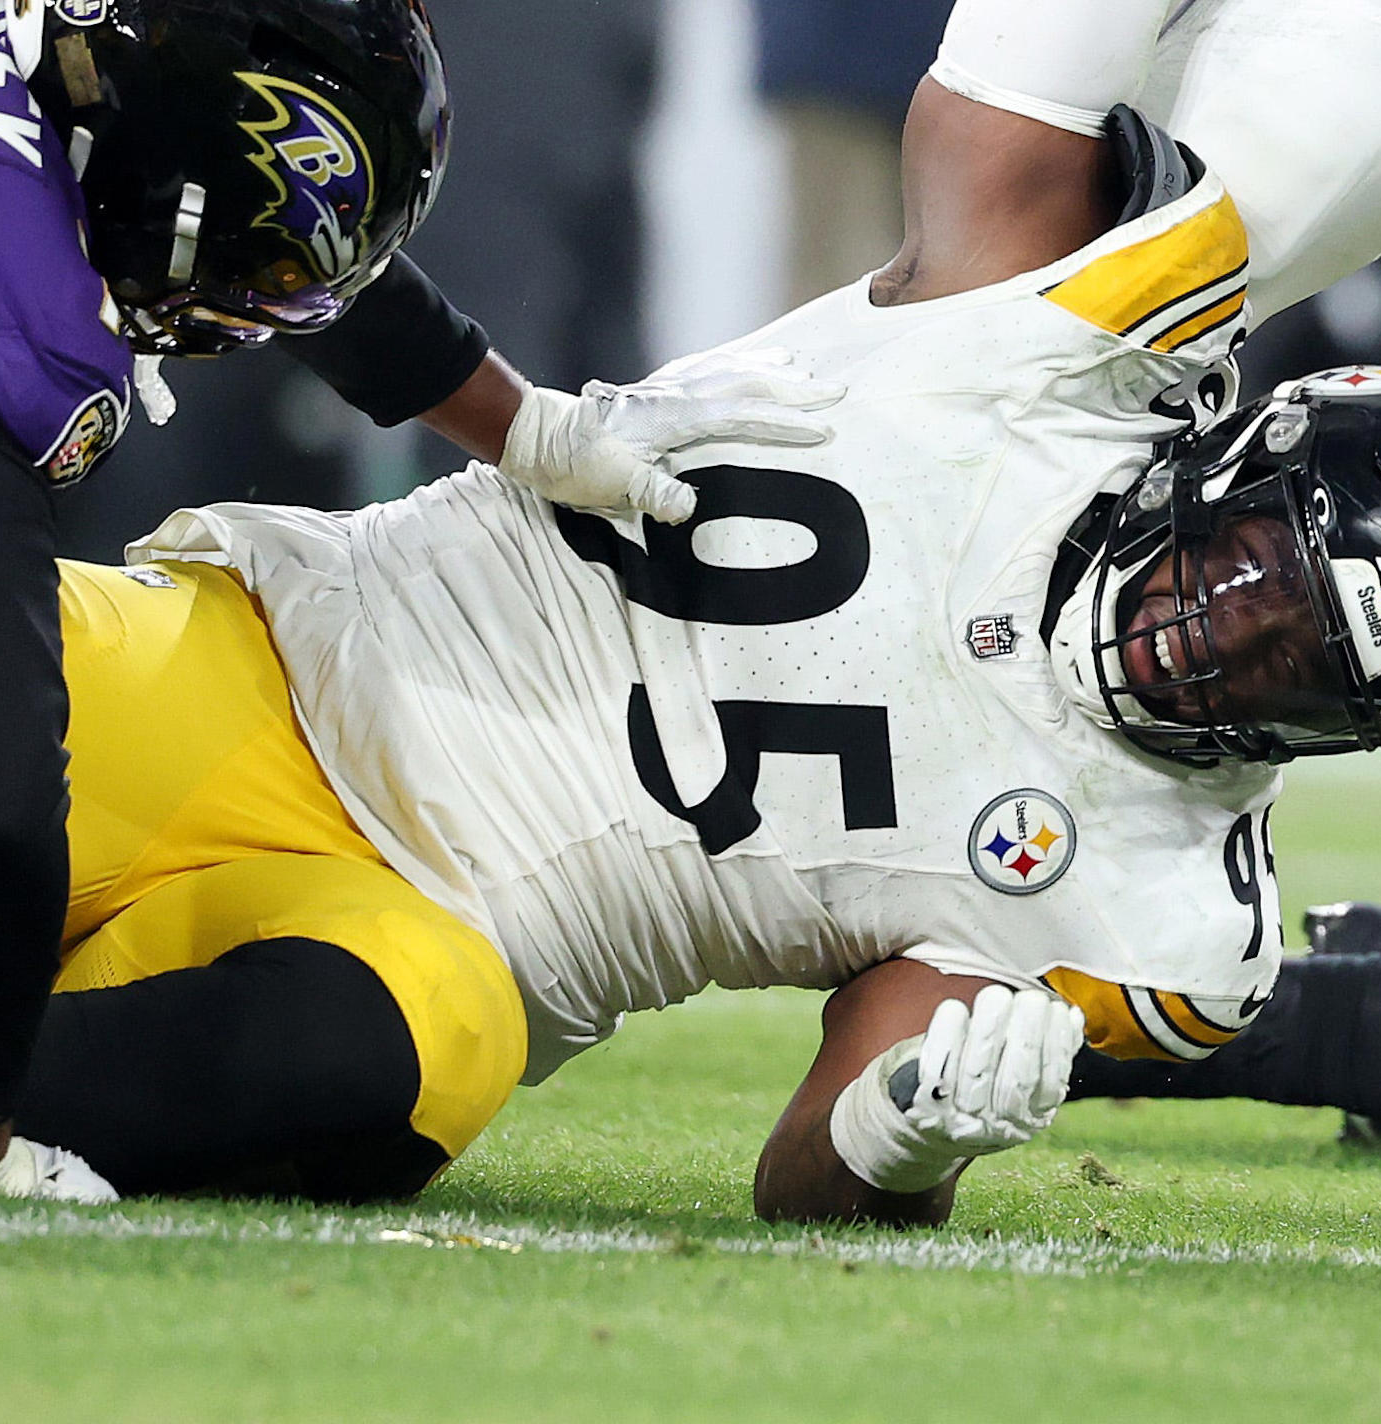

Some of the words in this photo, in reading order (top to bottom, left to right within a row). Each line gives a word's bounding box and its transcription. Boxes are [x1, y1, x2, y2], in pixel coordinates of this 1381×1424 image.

[553, 463, 899, 857] 95
[974, 623, 997, 655] NFL
[1014, 799, 1028, 841] Steelers
